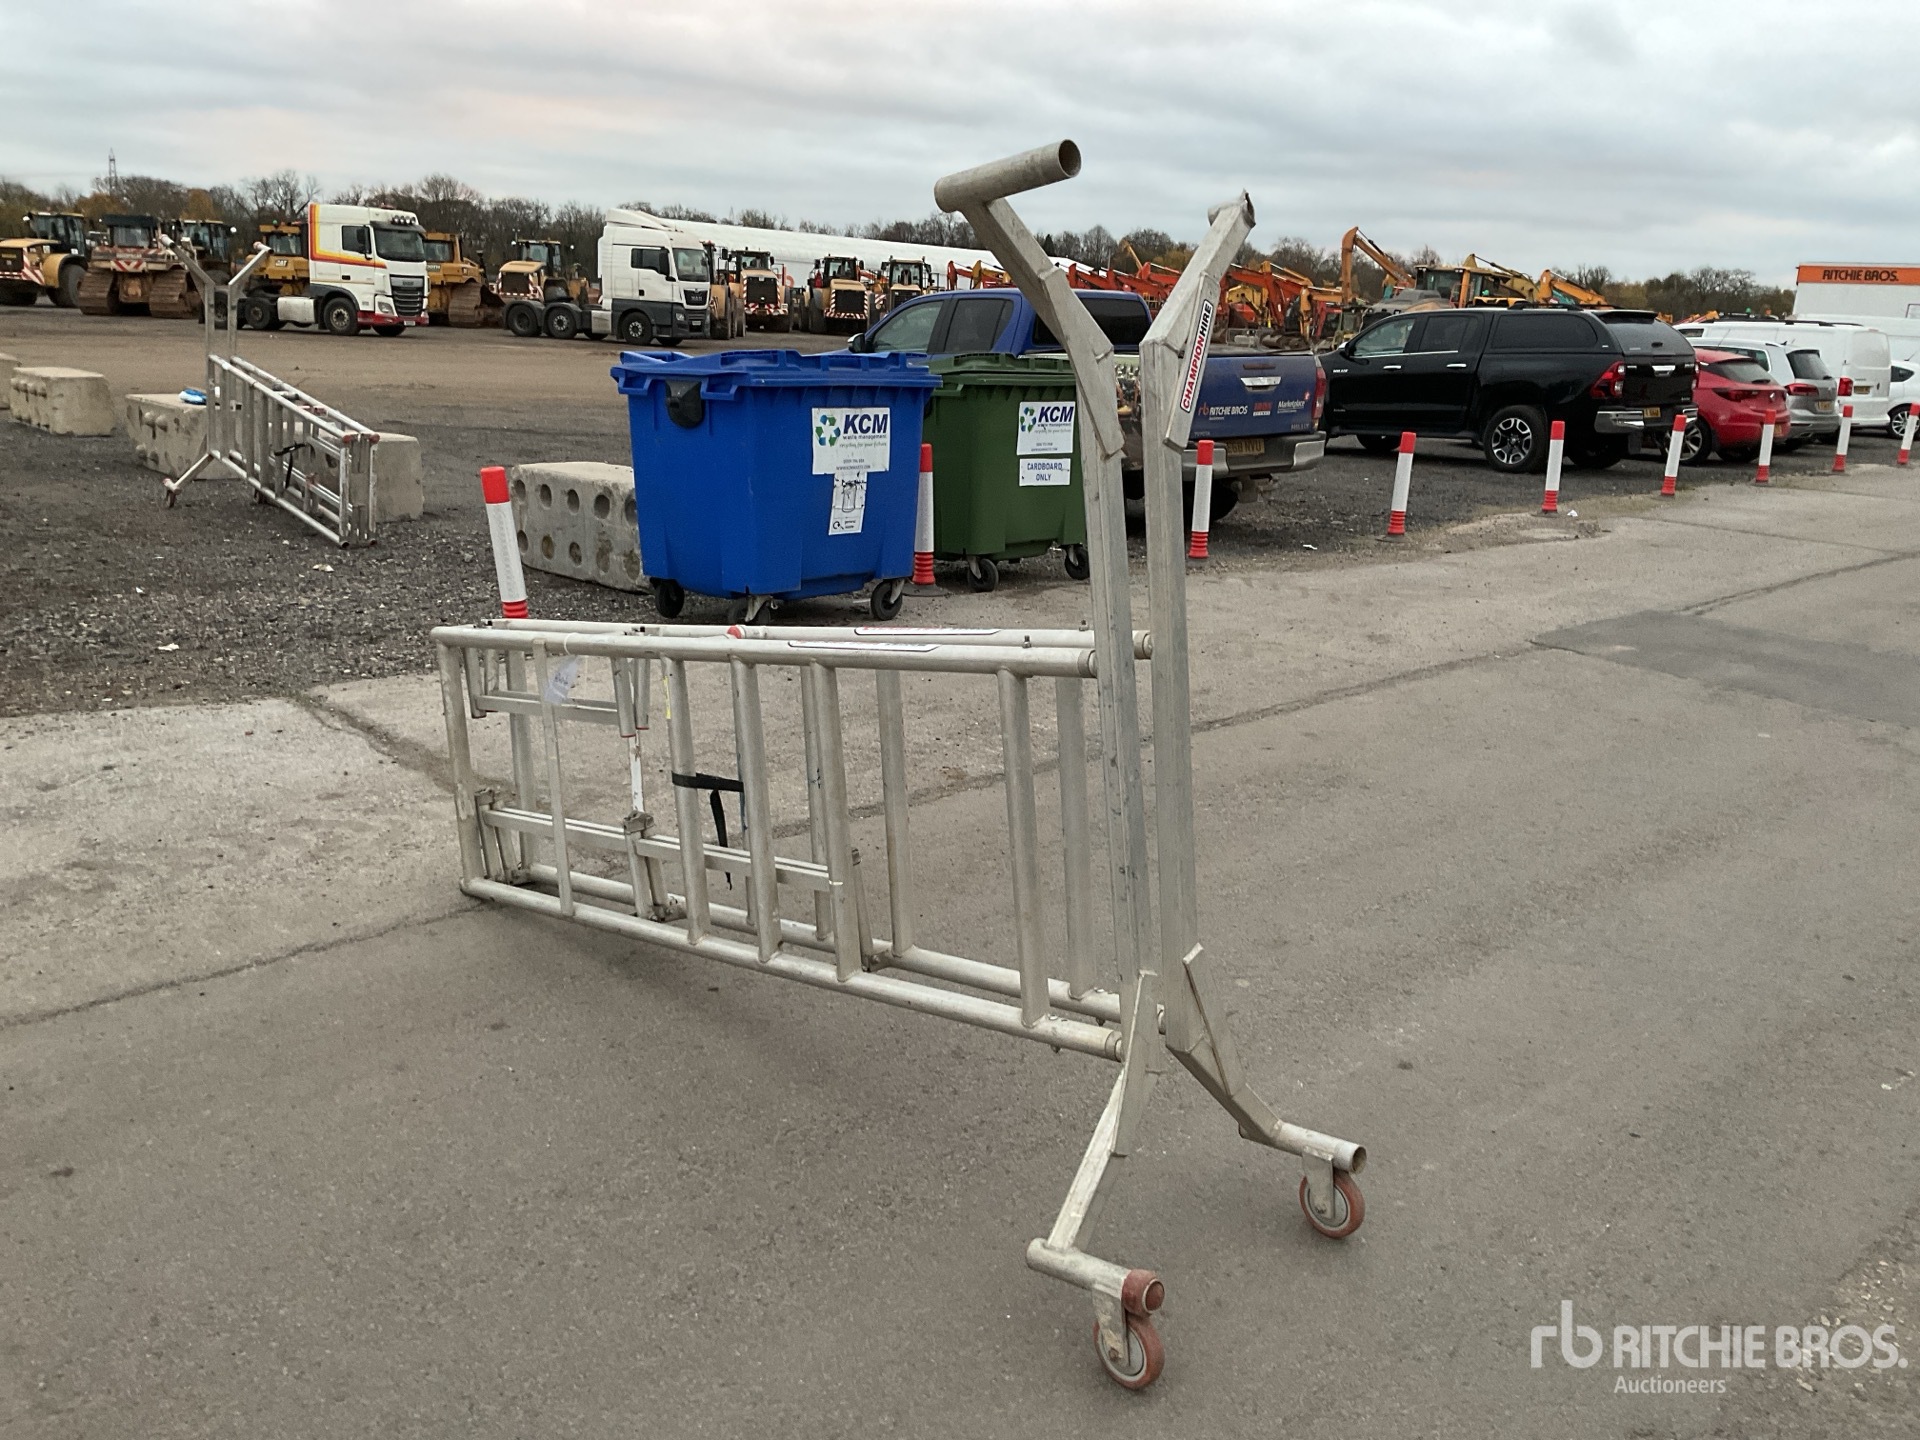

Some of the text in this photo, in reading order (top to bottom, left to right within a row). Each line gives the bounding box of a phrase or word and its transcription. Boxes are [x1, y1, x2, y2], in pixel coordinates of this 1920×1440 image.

[1822, 269, 1899, 282] RITCHIE BROS.
[1183, 303, 1212, 409] CHAMPIONHIRE
[1278, 400, 1305, 409] Marketplace
[1038, 406, 1074, 423] KCM
[1209, 406, 1231, 415] RITCHIE
[843, 413, 888, 434] KCM
[1027, 462, 1062, 471] CARDBOARD
[1035, 473, 1051, 481] ONLY
